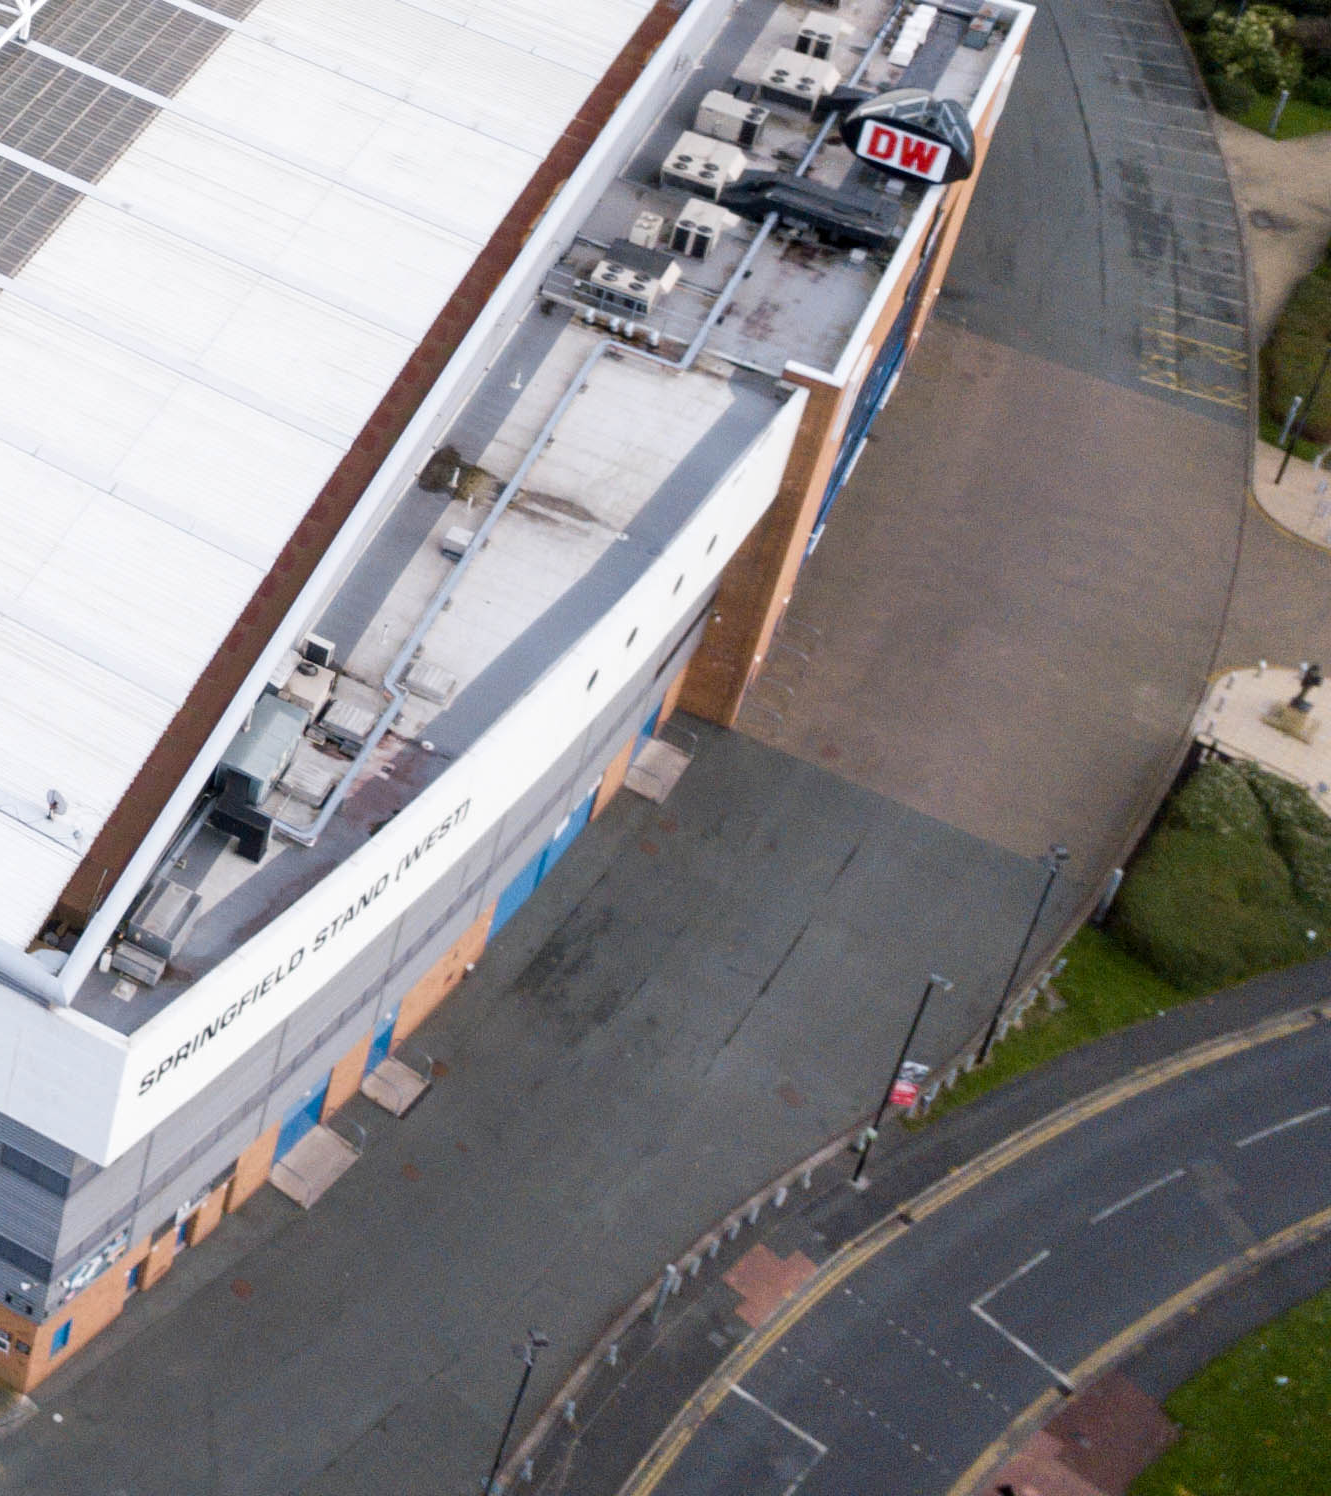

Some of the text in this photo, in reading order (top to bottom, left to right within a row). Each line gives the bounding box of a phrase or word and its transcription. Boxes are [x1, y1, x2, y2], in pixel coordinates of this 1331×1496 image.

[867, 125, 940, 174] DW
[137, 948, 306, 1097] SPRINGFIELD
[313, 871, 391, 953] STAND
